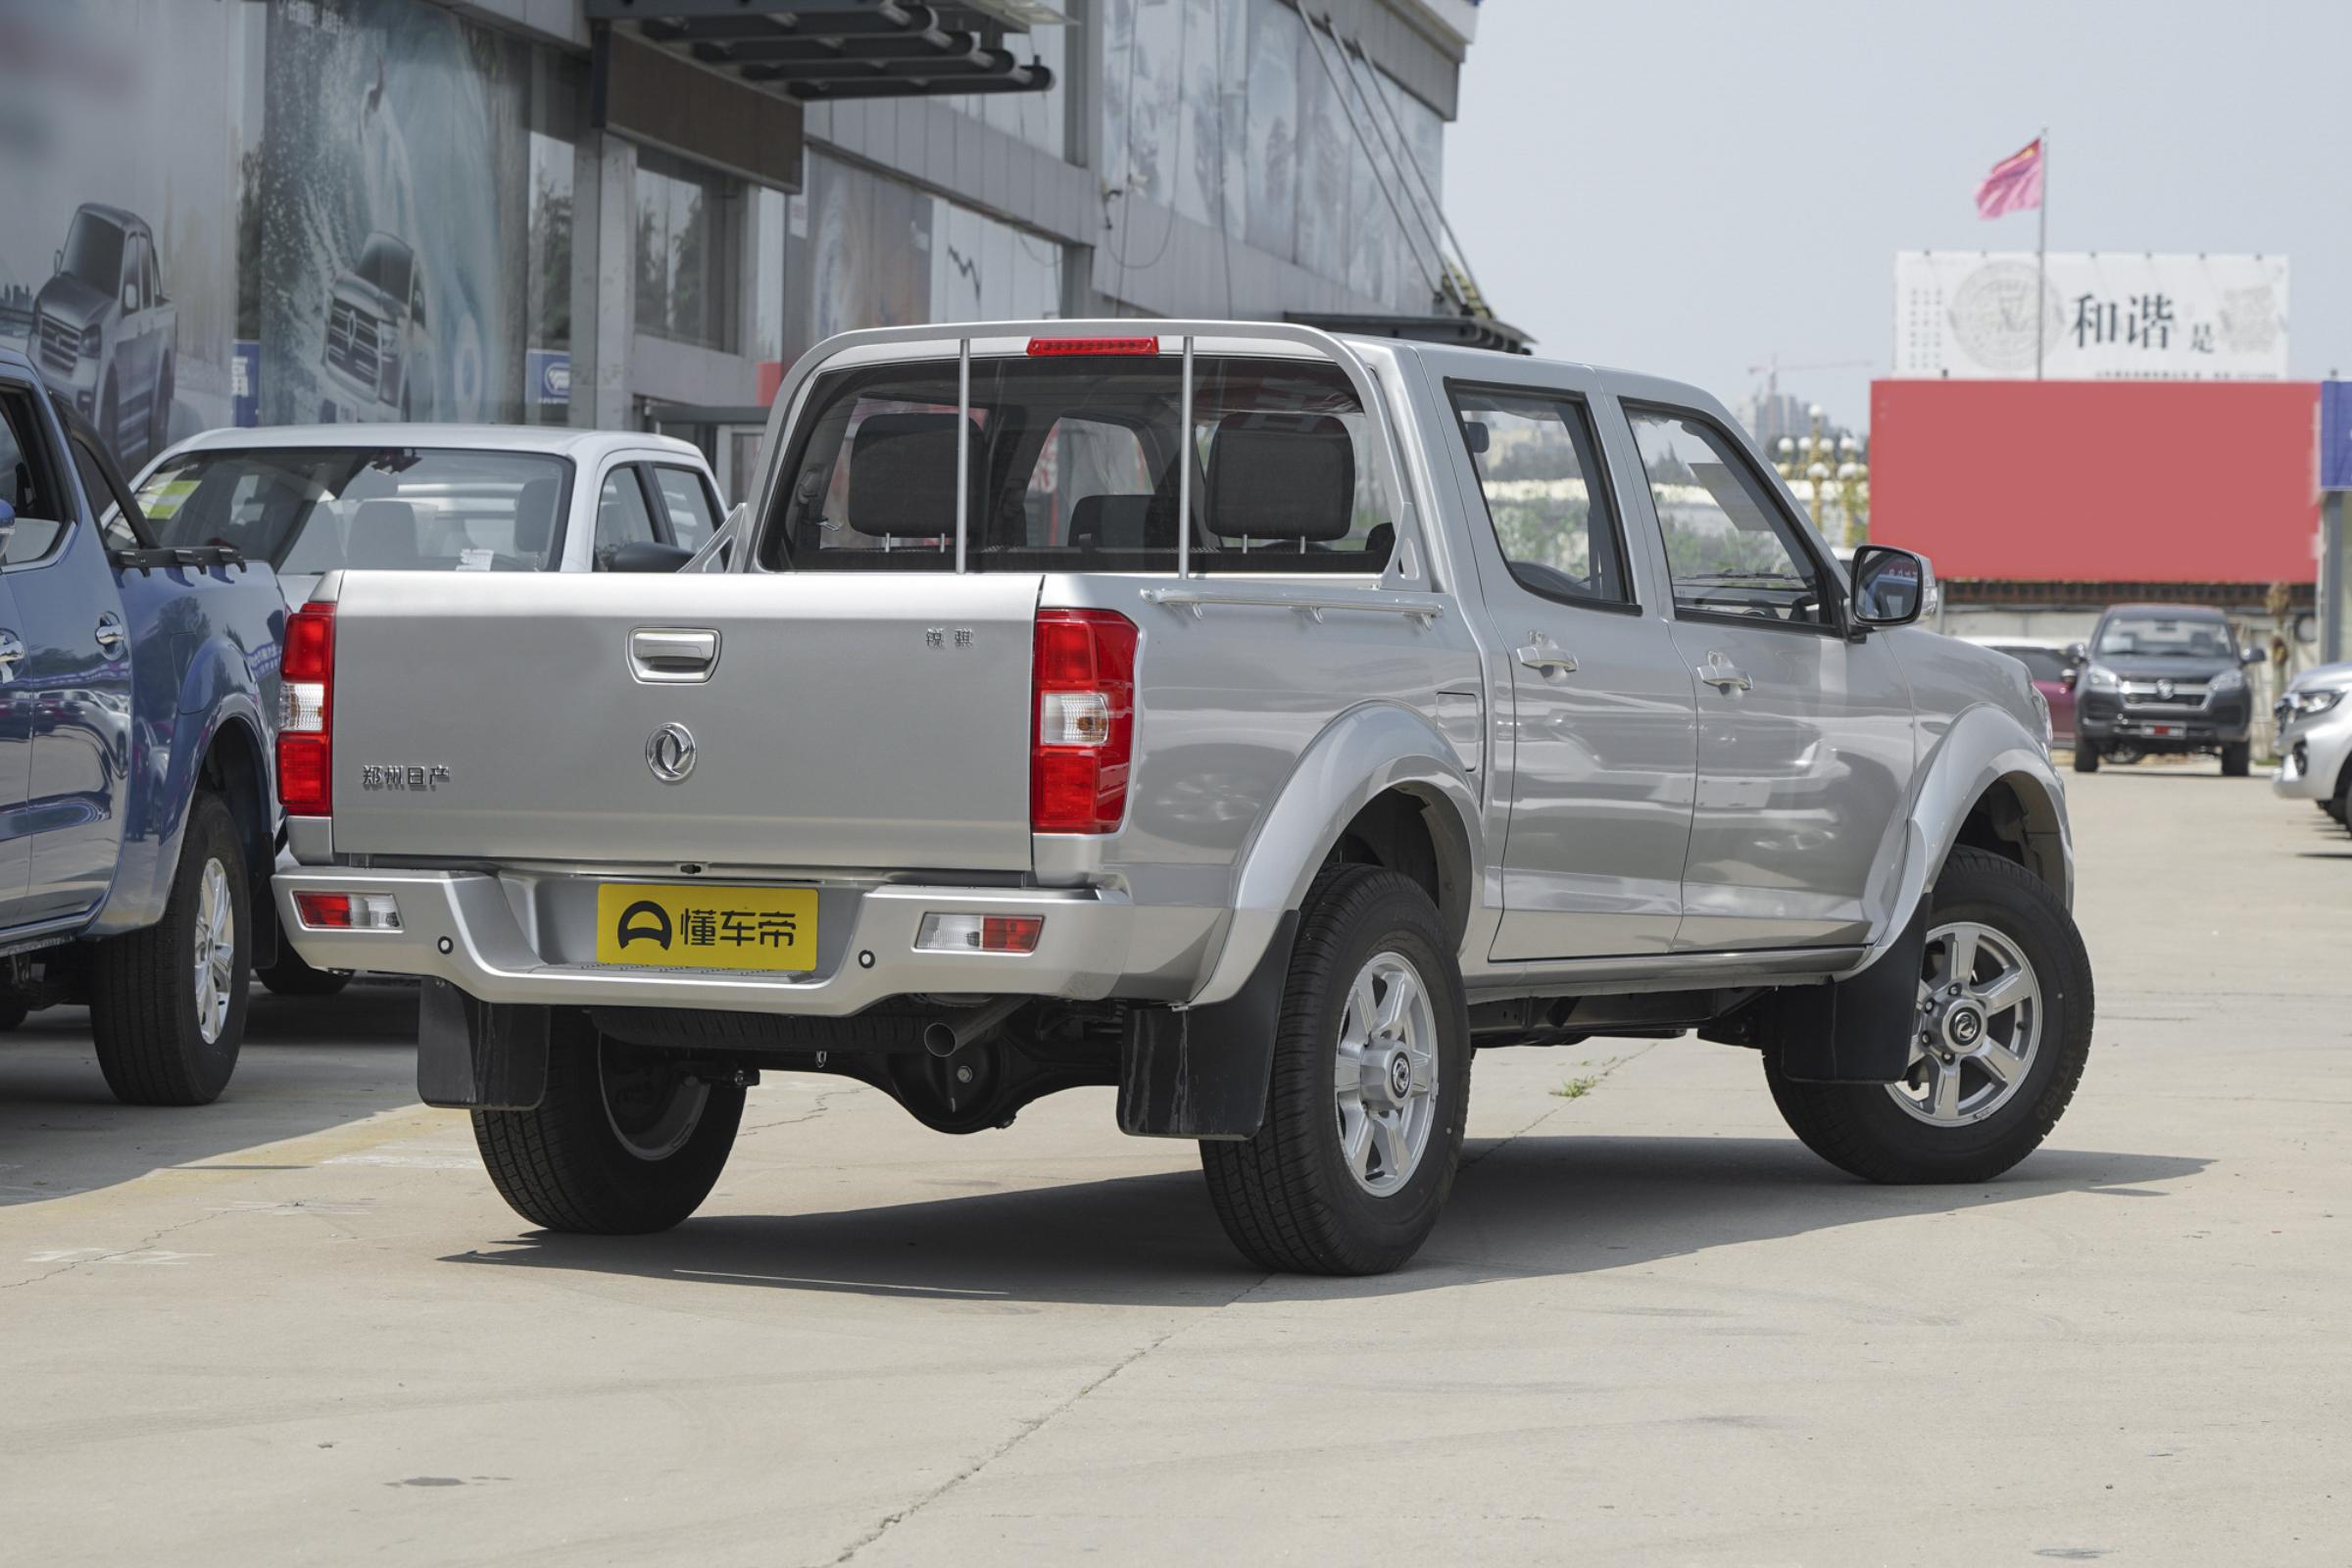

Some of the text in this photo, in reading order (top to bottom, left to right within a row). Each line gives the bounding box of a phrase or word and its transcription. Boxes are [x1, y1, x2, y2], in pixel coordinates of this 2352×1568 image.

[925, 627, 973, 648] 锐骐
[363, 764, 450, 787] 郑州日产
[680, 907, 797, 948] 懂车帝
